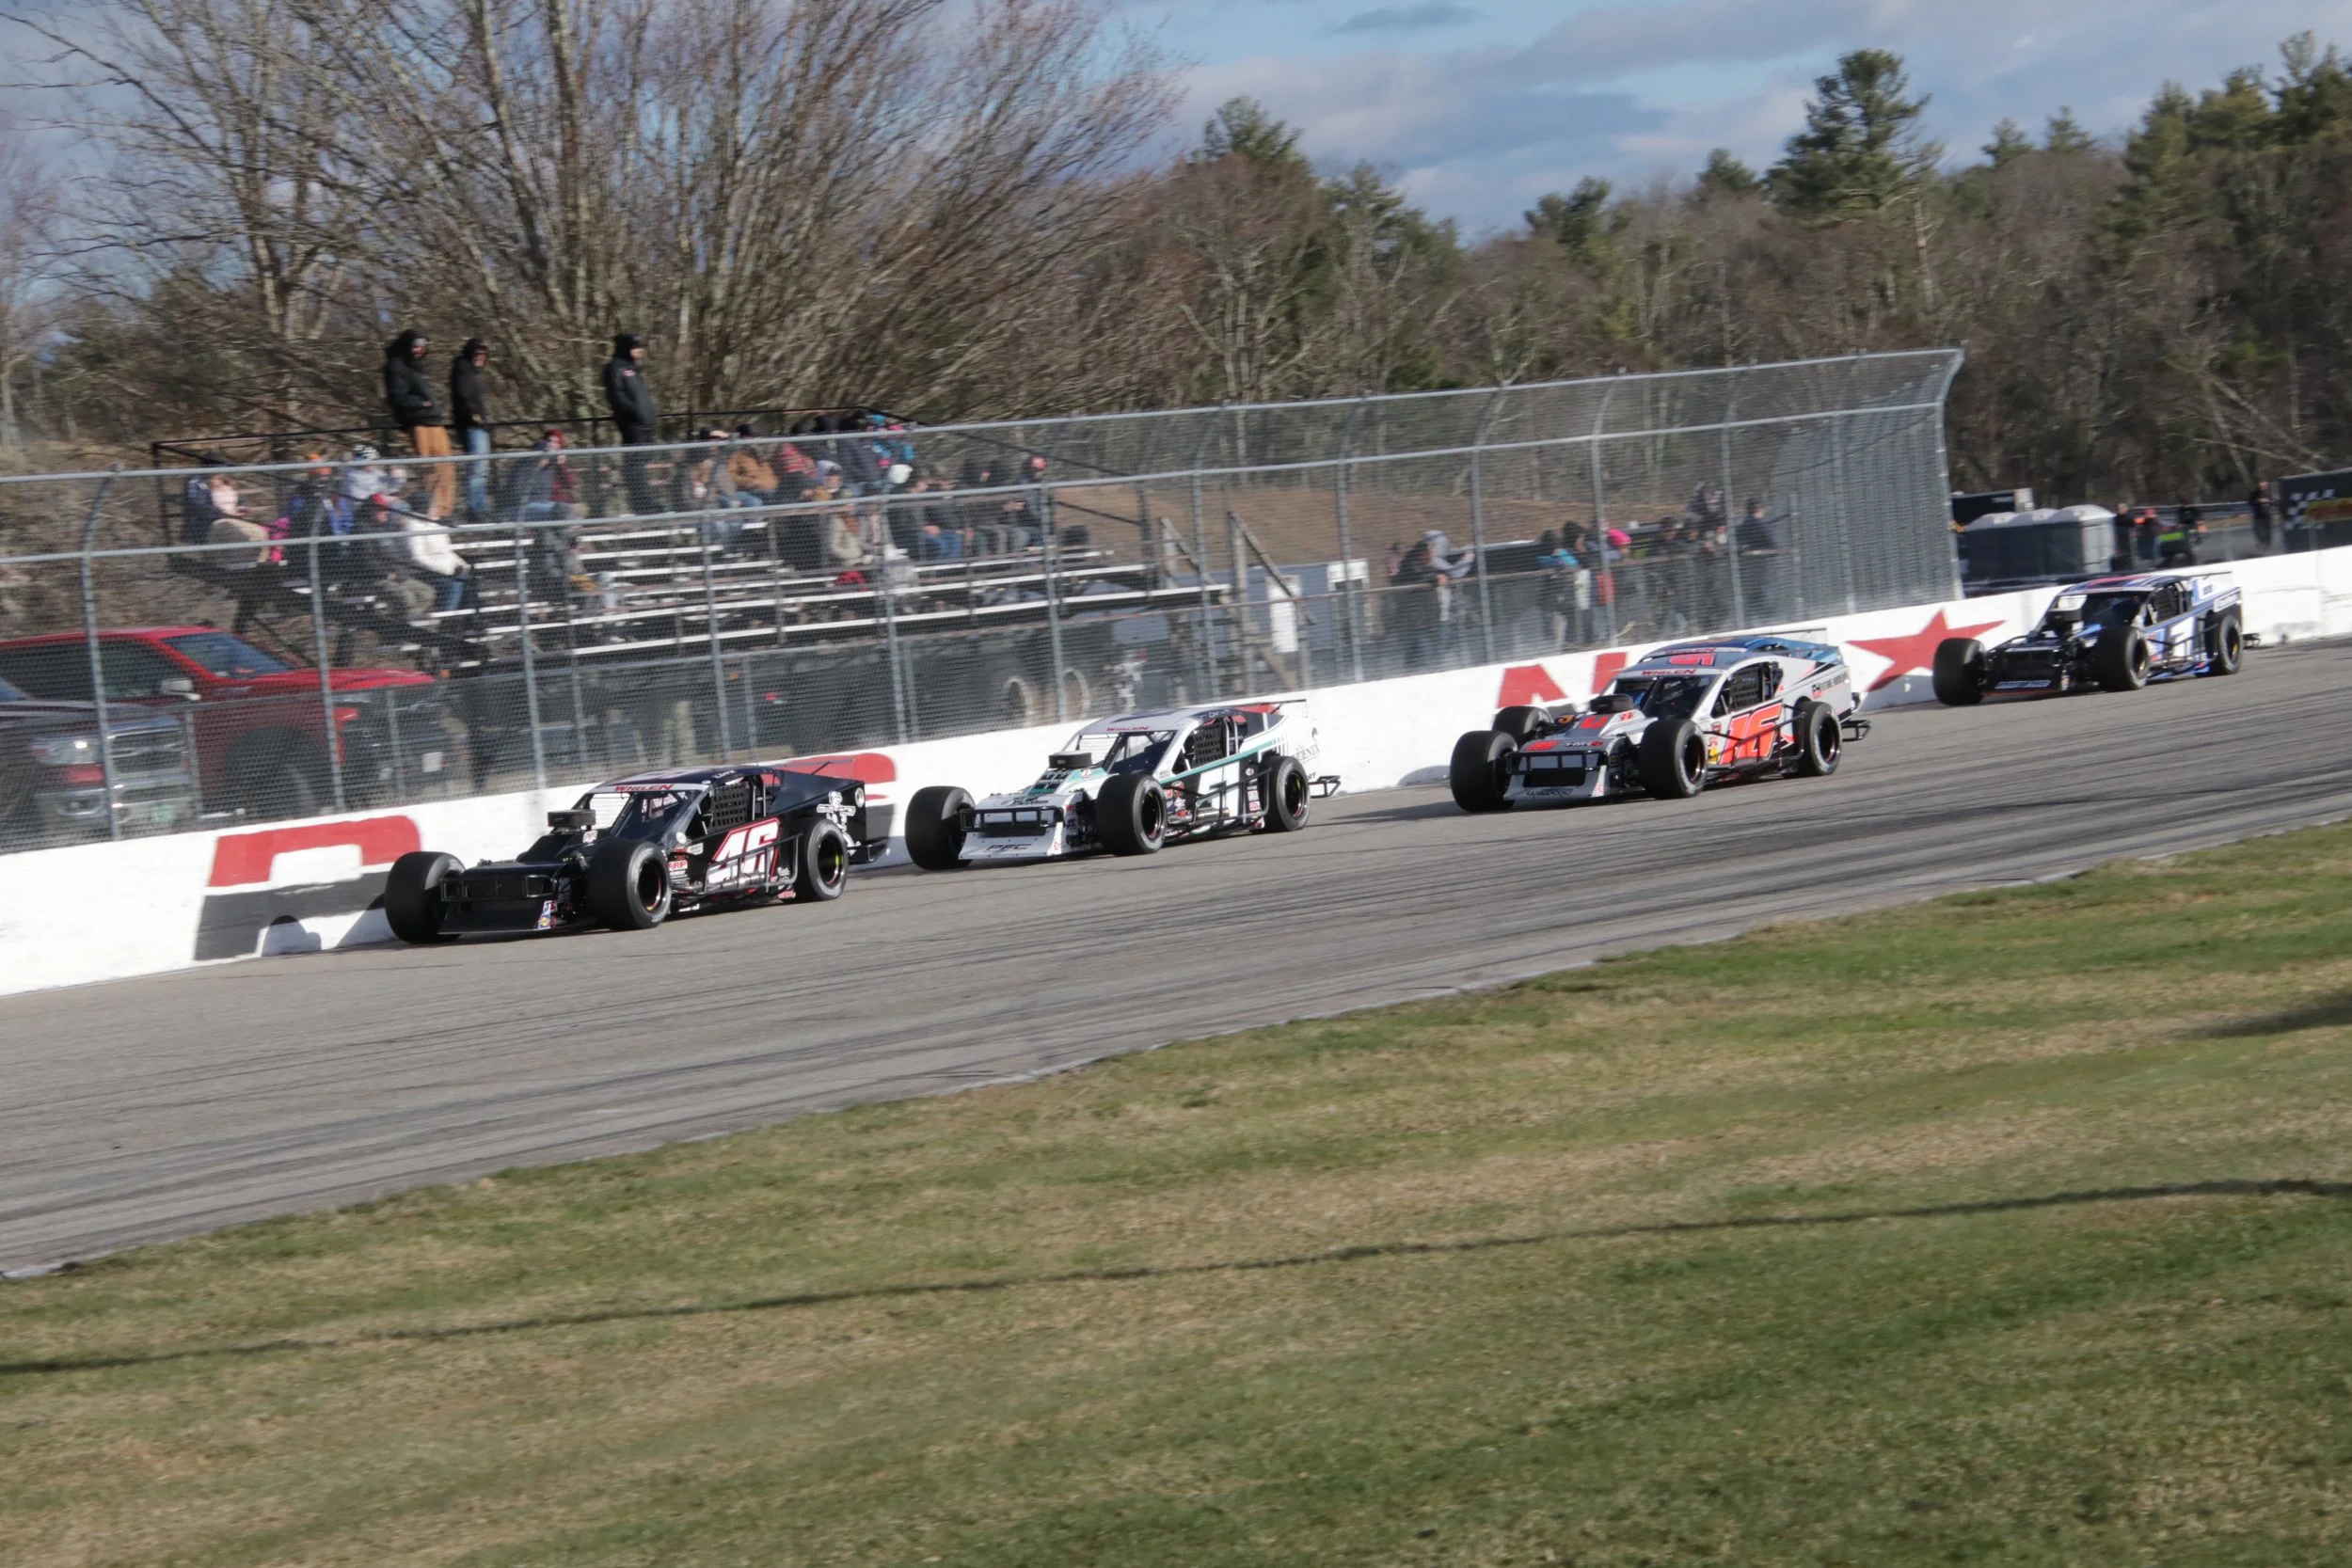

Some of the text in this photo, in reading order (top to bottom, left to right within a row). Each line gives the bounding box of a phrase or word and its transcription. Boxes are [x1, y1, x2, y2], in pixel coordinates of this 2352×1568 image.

[1720, 699, 1784, 766] 16
[614, 784, 674, 792] WHELEN
[707, 816, 783, 885] 46
